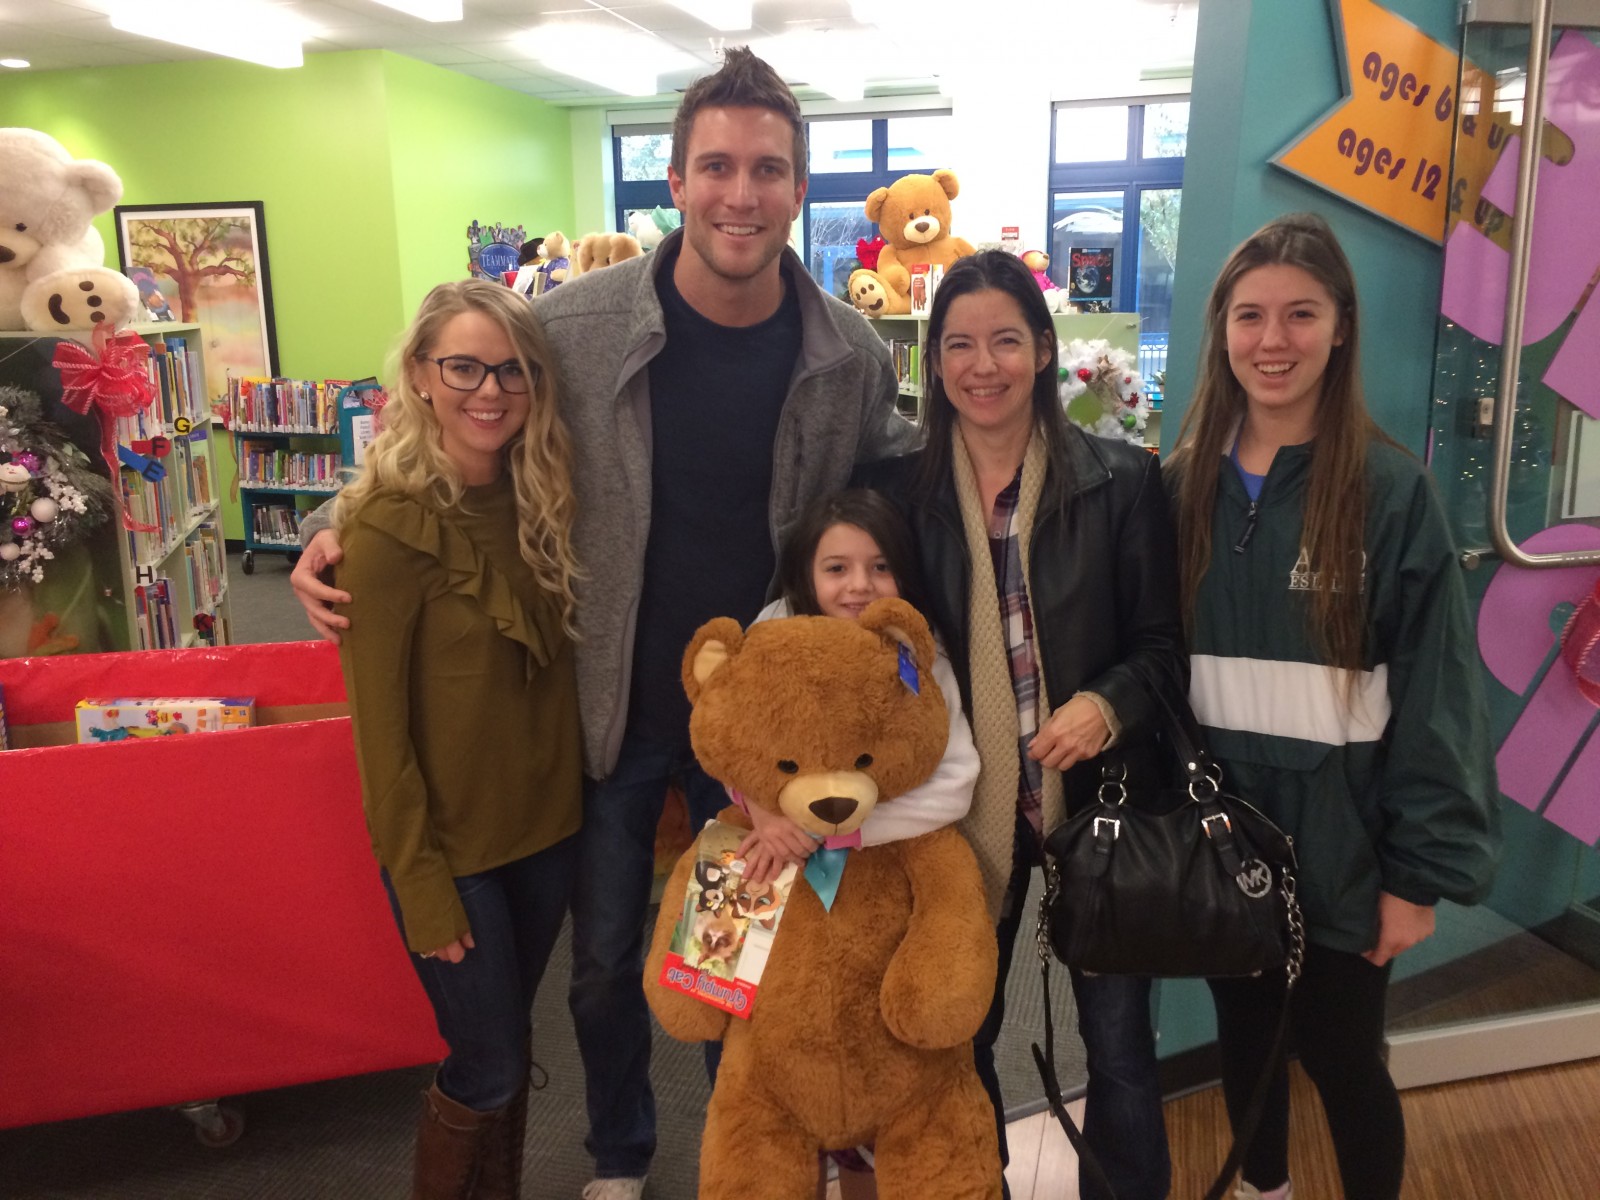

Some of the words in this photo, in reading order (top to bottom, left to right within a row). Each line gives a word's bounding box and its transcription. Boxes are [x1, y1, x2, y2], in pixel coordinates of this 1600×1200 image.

[1363, 51, 1431, 107] ages
[1435, 84, 1452, 122] 6
[1337, 127, 1406, 181] ages
[1411, 157, 1442, 201] 12
[174, 416, 191, 434] G
[152, 436, 165, 456] F
[142, 460, 164, 482] E
[135, 565, 153, 584] H
[667, 968, 694, 990] Cat
[696, 974, 747, 1011] Grumpy
